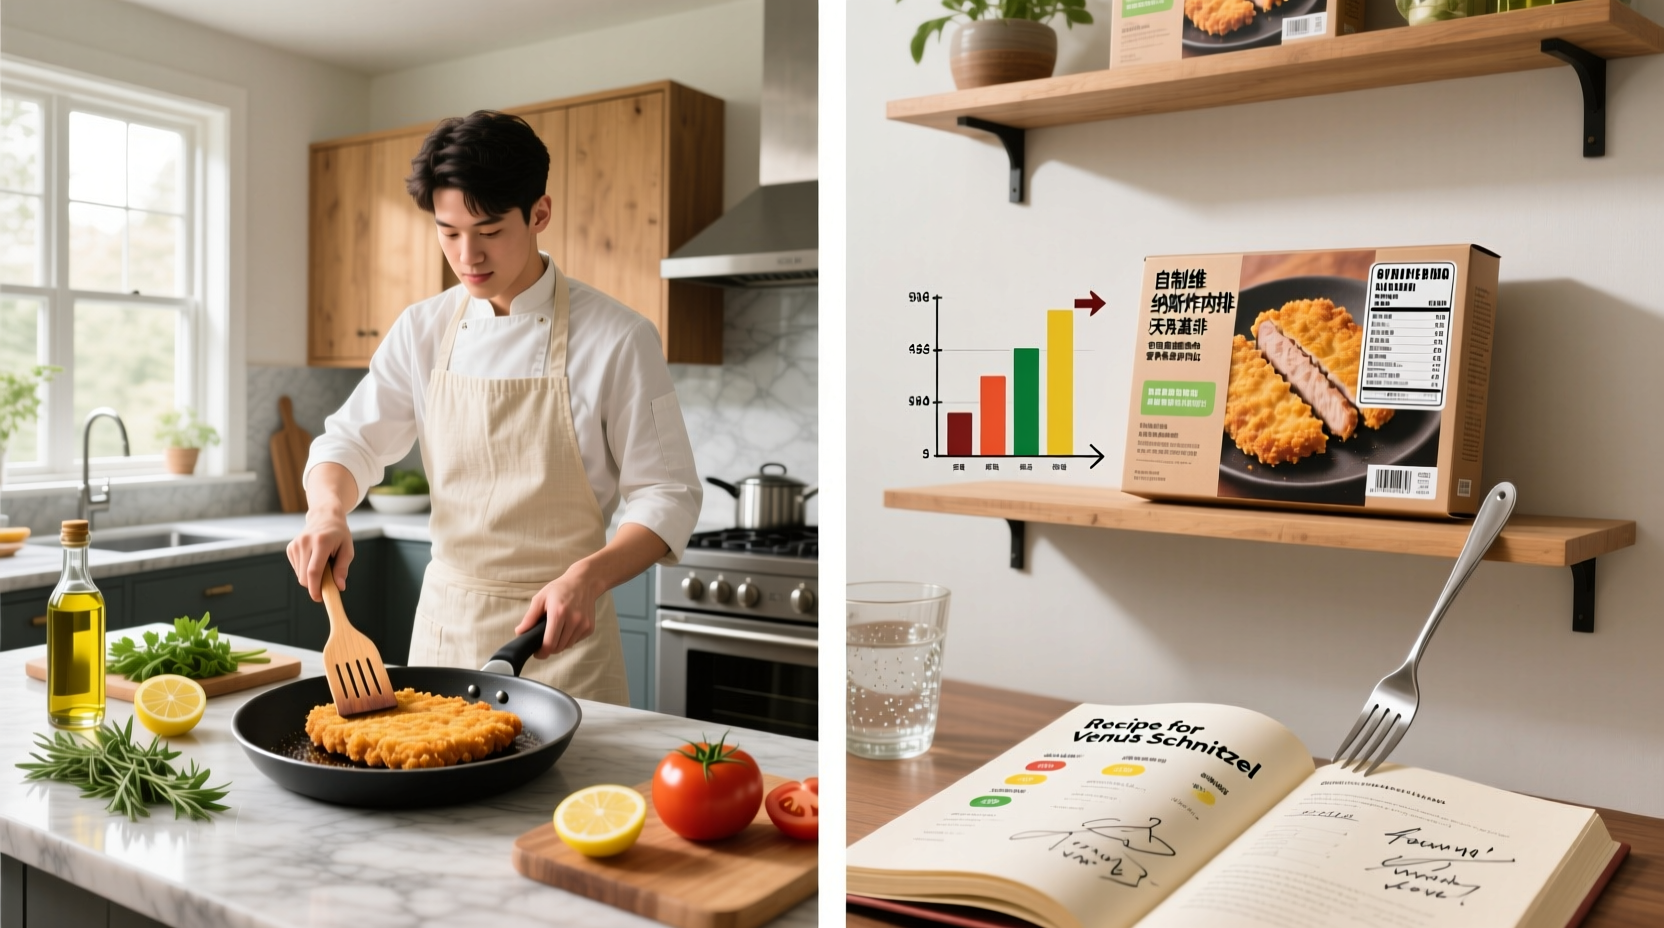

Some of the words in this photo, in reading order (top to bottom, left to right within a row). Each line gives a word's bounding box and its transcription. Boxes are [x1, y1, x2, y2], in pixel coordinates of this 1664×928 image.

[1083, 718, 1163, 734] Recipe
[1167, 720, 1205, 735] for
[1073, 731, 1143, 743] Venus
[1146, 732, 1262, 780] Schnitzel
